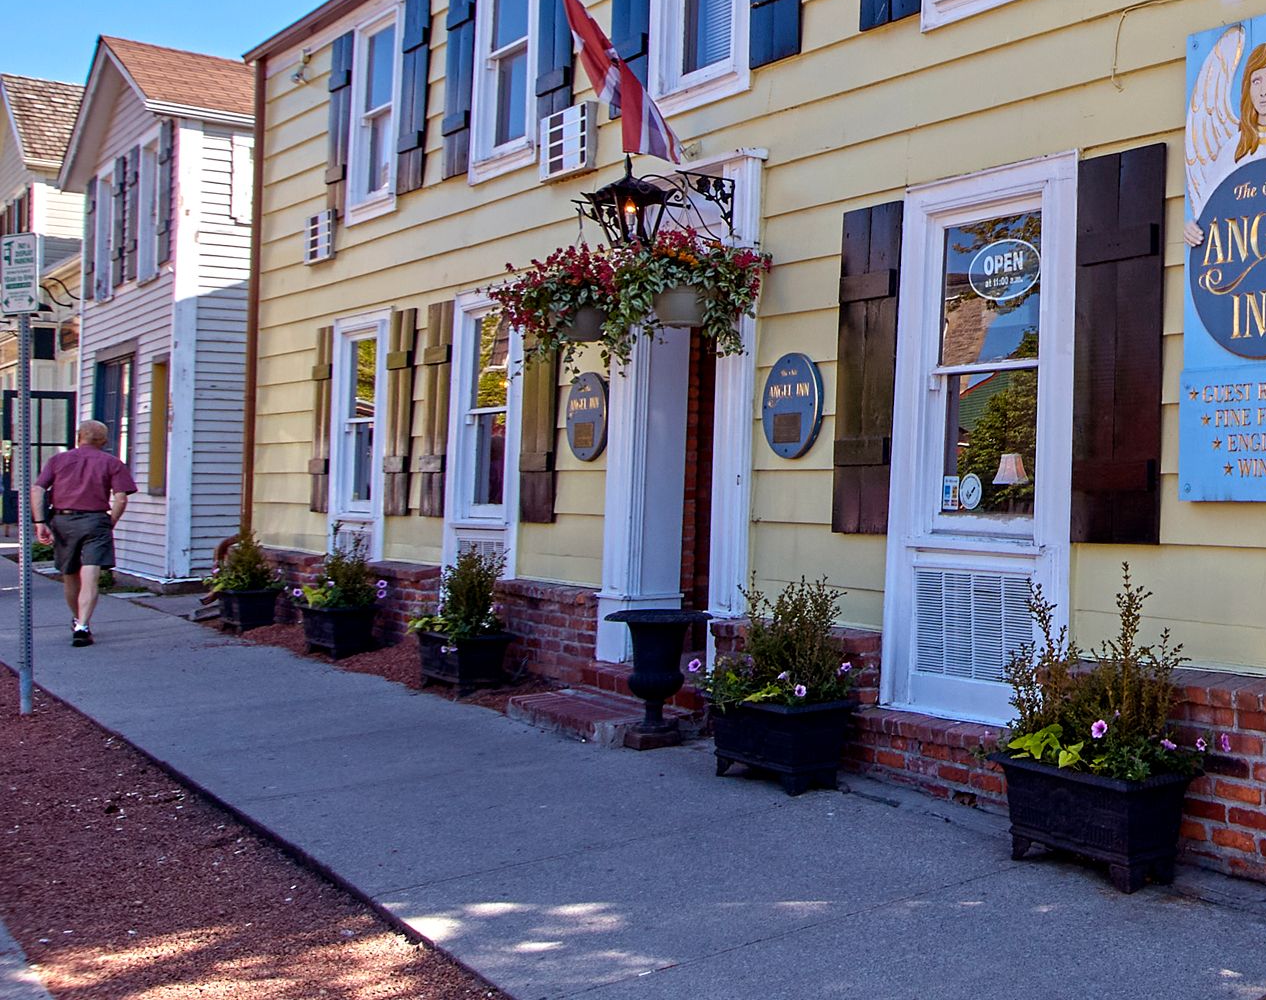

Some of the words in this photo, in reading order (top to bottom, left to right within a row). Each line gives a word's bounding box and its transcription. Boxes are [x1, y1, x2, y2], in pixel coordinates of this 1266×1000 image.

[1233, 182, 1257, 200] The
[984, 250, 1024, 276] OPEN
[985, 278, 992, 288] at
[993, 276, 1009, 287] 11:00
[769, 383, 792, 399] ANGEL
[796, 382, 810, 397] INN
[1202, 383, 1252, 403] GUEST
[589, 396, 599, 409] INN
[1215, 408, 1251, 427] FINE
